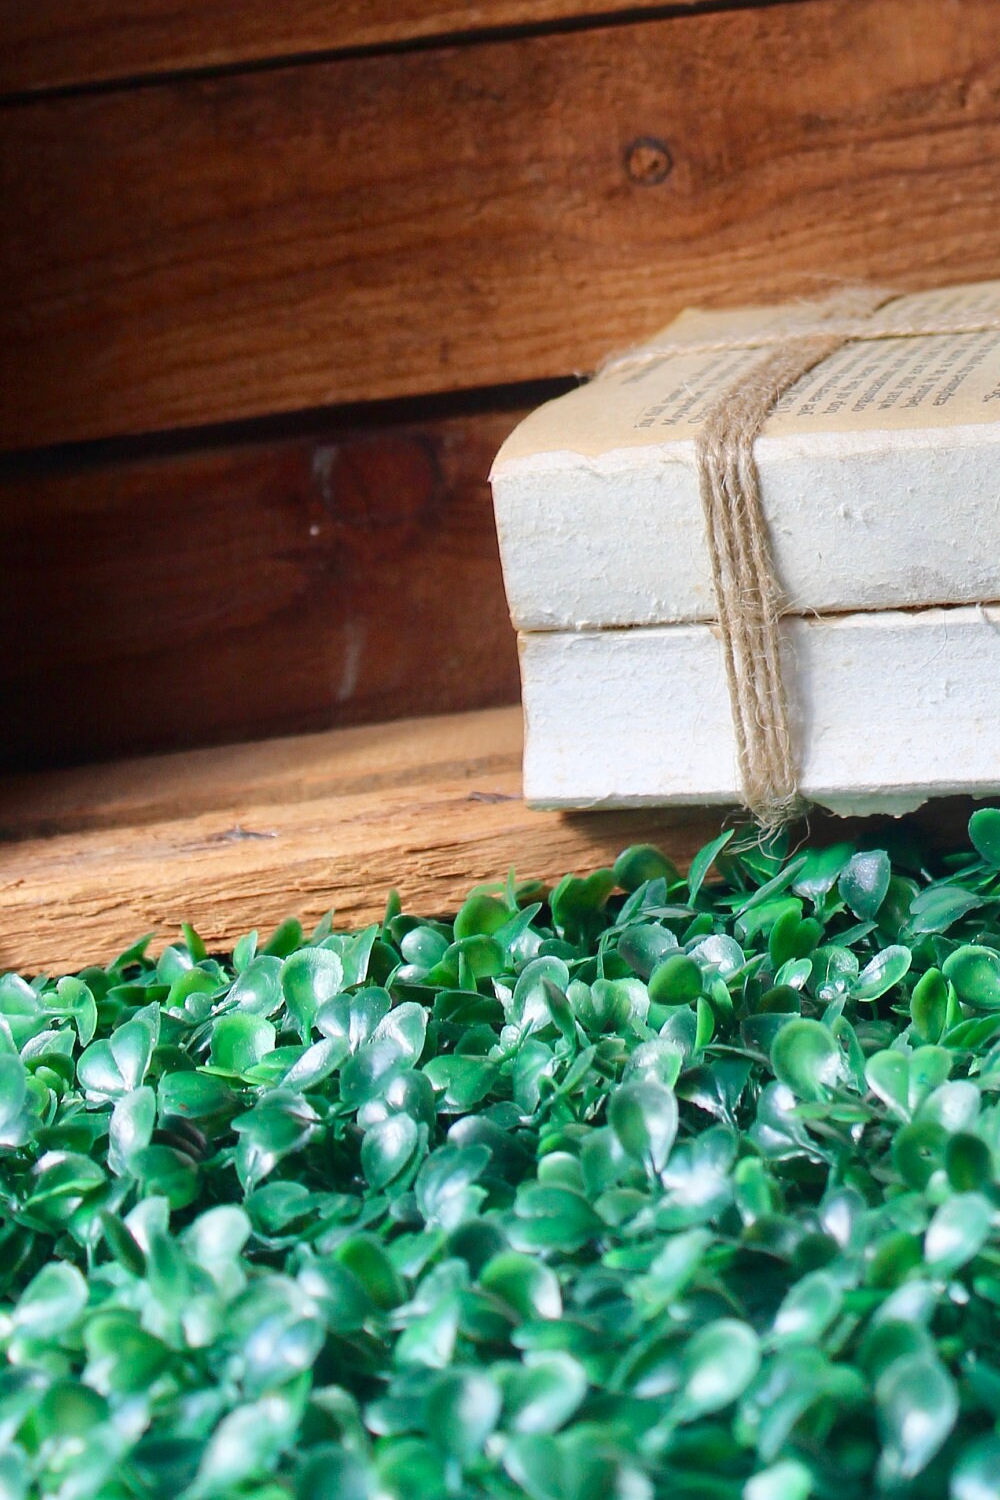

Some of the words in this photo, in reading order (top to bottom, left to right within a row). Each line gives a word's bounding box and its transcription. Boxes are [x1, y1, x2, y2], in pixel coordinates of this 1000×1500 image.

[878, 392, 902, 410] what
[895, 377, 916, 389] you
[910, 365, 927, 374] are
[900, 385, 934, 408] behind
[822, 401, 846, 413] top
